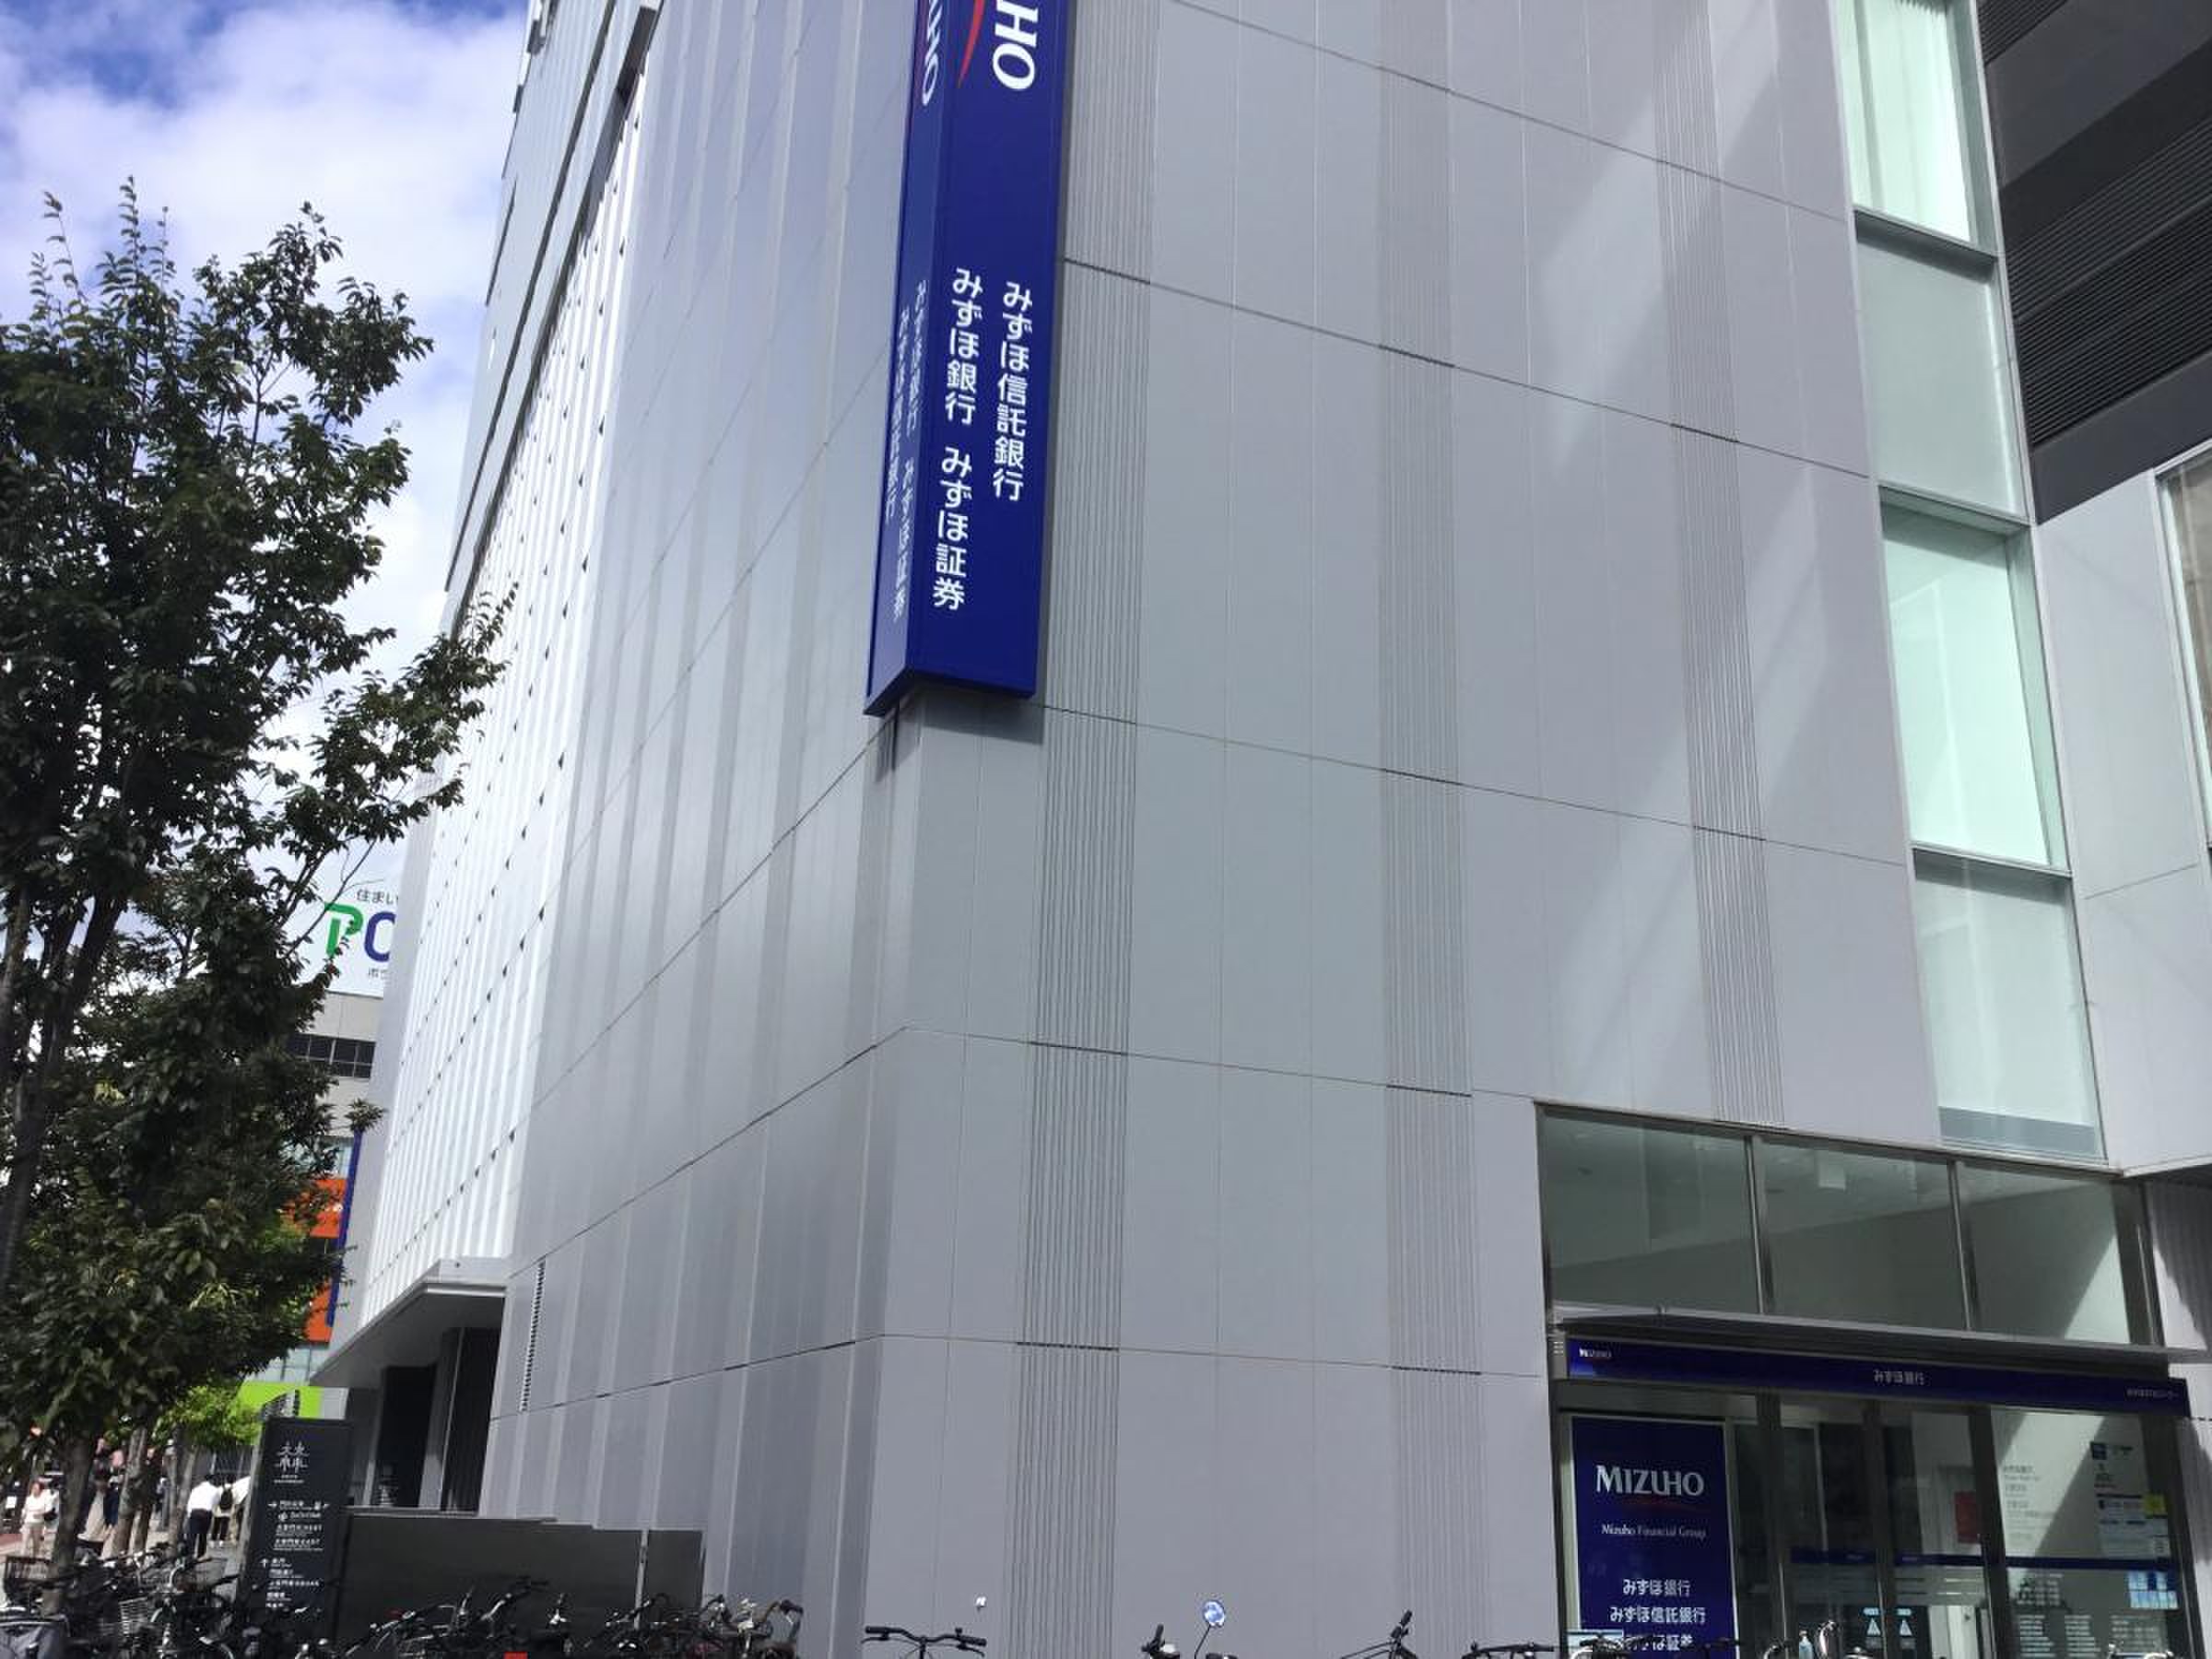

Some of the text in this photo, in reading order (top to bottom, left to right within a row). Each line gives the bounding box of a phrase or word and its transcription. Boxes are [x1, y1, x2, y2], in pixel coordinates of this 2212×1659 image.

[993, 0, 1039, 90] HO
[992, 281, 1033, 501] みずほ信託銀行
[932, 267, 983, 611] みずほ銀行 みずほ証券
[1595, 1465, 1705, 1497] MIZUHO
[1609, 1606, 1707, 1624] みずほ信託銀行
[1622, 1578, 1691, 1597] みずほ銀行
